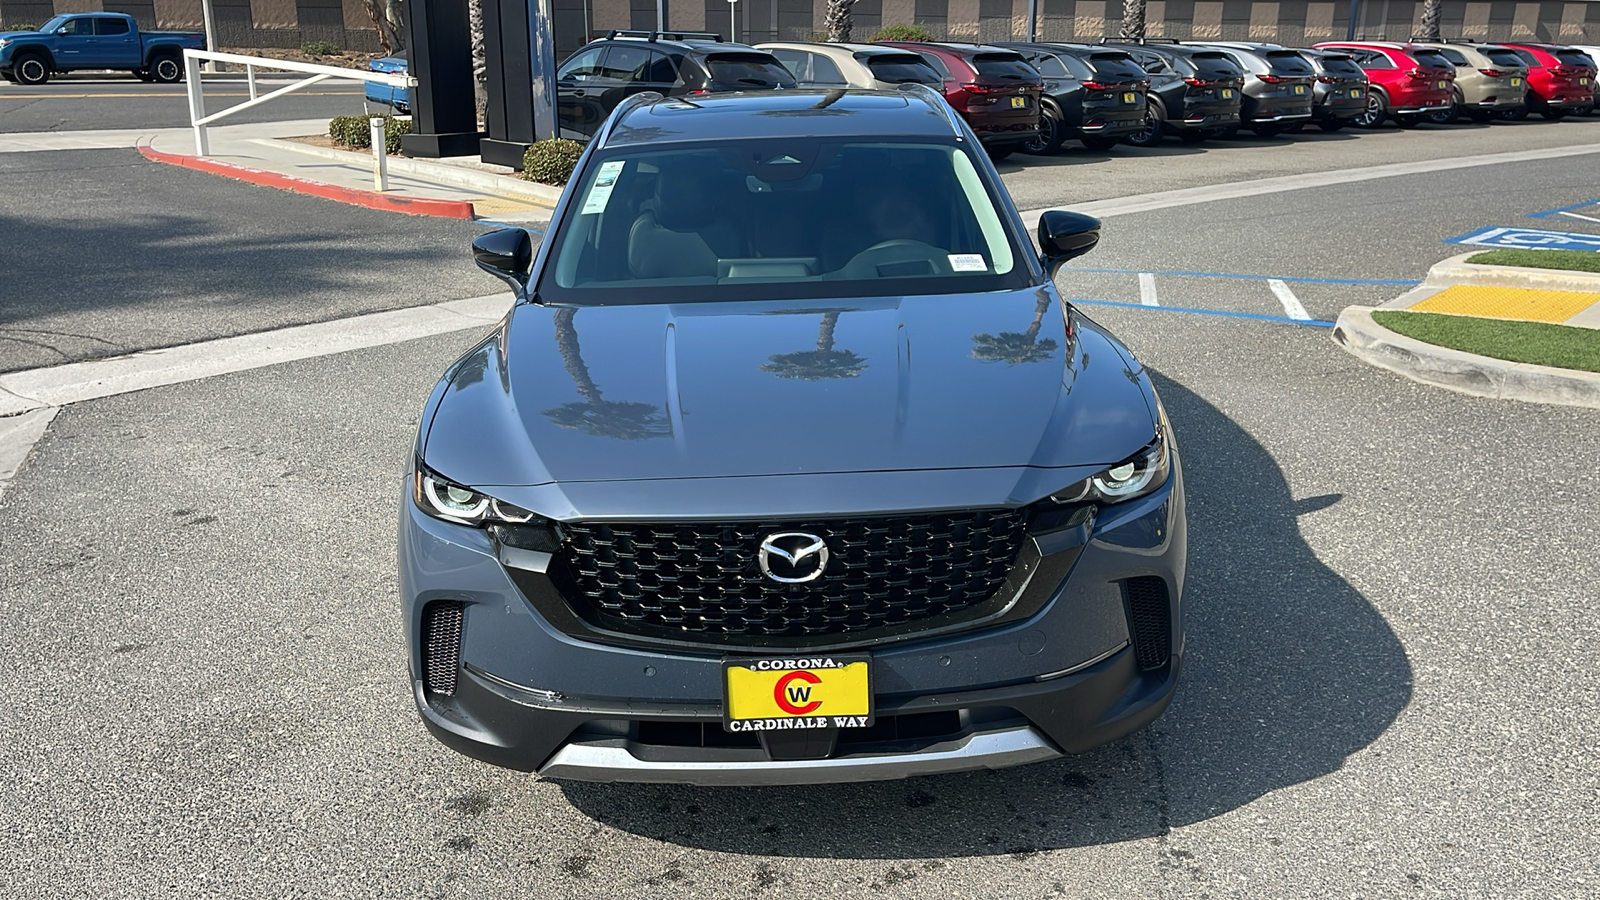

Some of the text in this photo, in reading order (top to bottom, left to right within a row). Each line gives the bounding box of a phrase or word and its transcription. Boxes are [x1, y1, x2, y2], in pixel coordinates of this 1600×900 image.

[758, 658, 836, 670] CORONA
[730, 716, 869, 732] CARDINALE WAY
